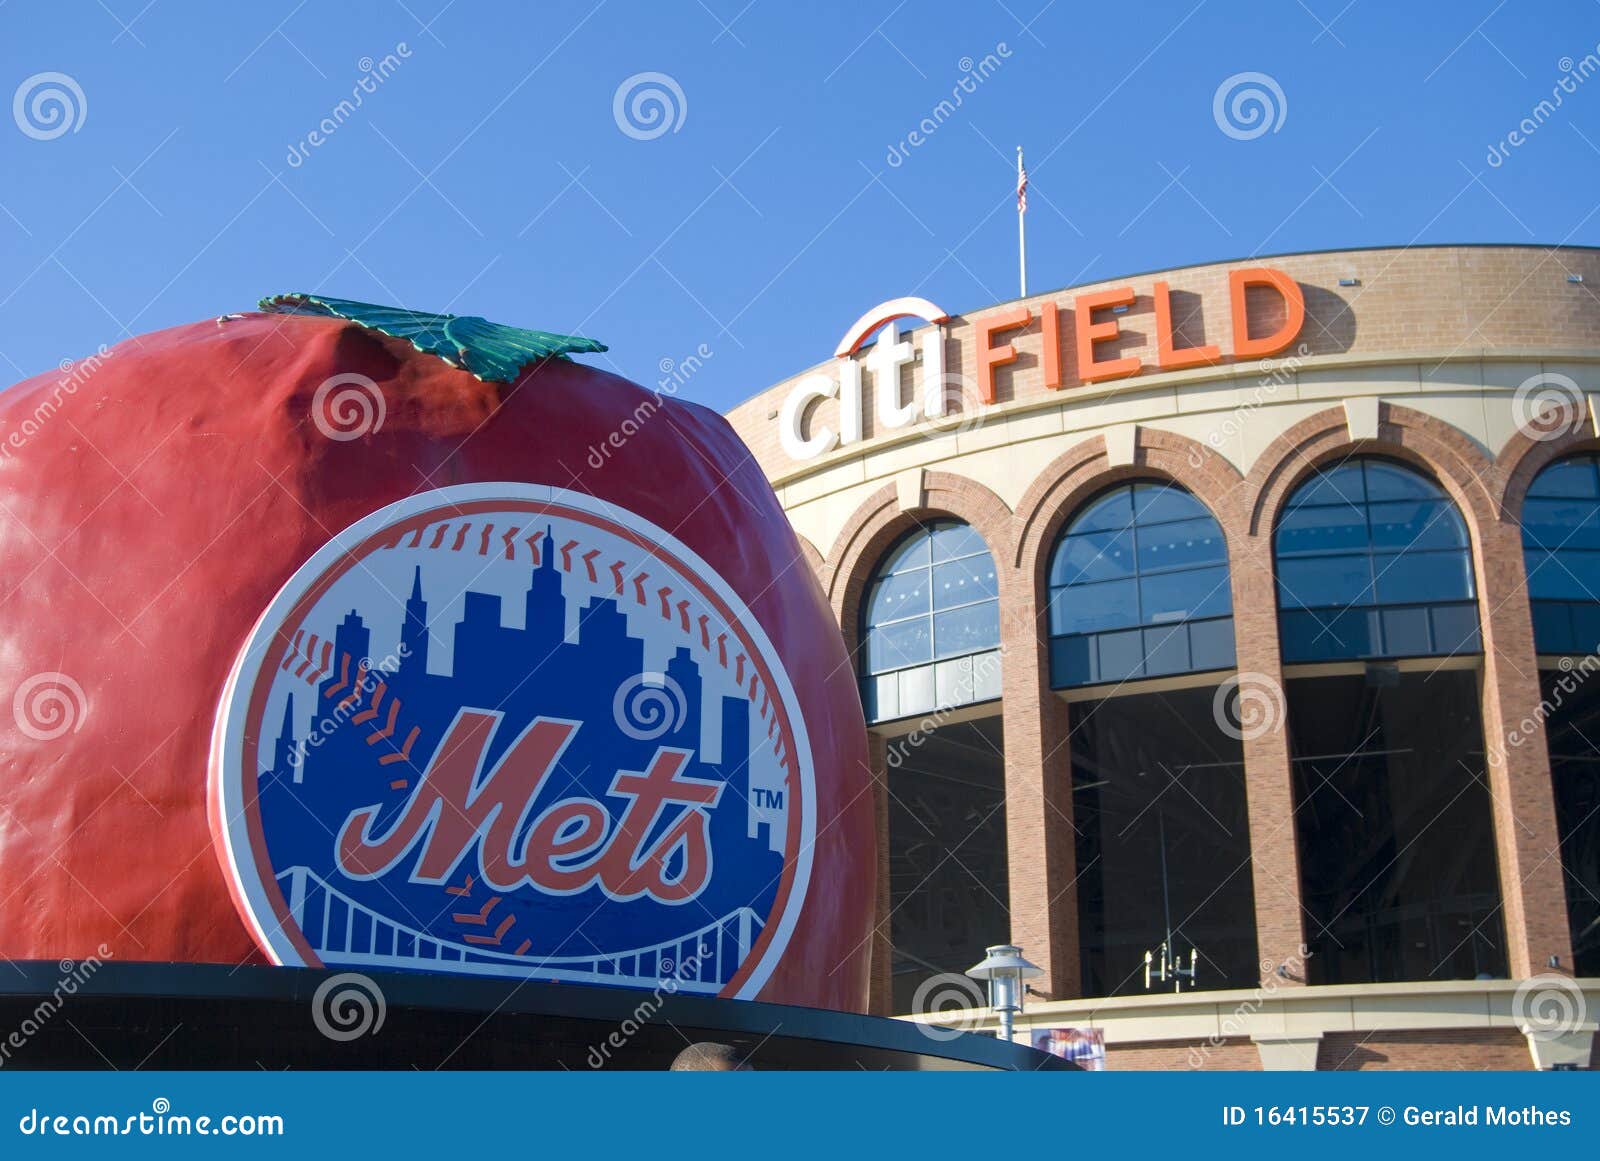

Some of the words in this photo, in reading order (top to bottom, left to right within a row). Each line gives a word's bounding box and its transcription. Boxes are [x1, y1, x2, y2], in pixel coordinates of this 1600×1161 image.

[780, 299, 950, 460] citi
[975, 267, 1305, 405] FIELD
[334, 706, 727, 906] Mets
[752, 787, 785, 810] TM
